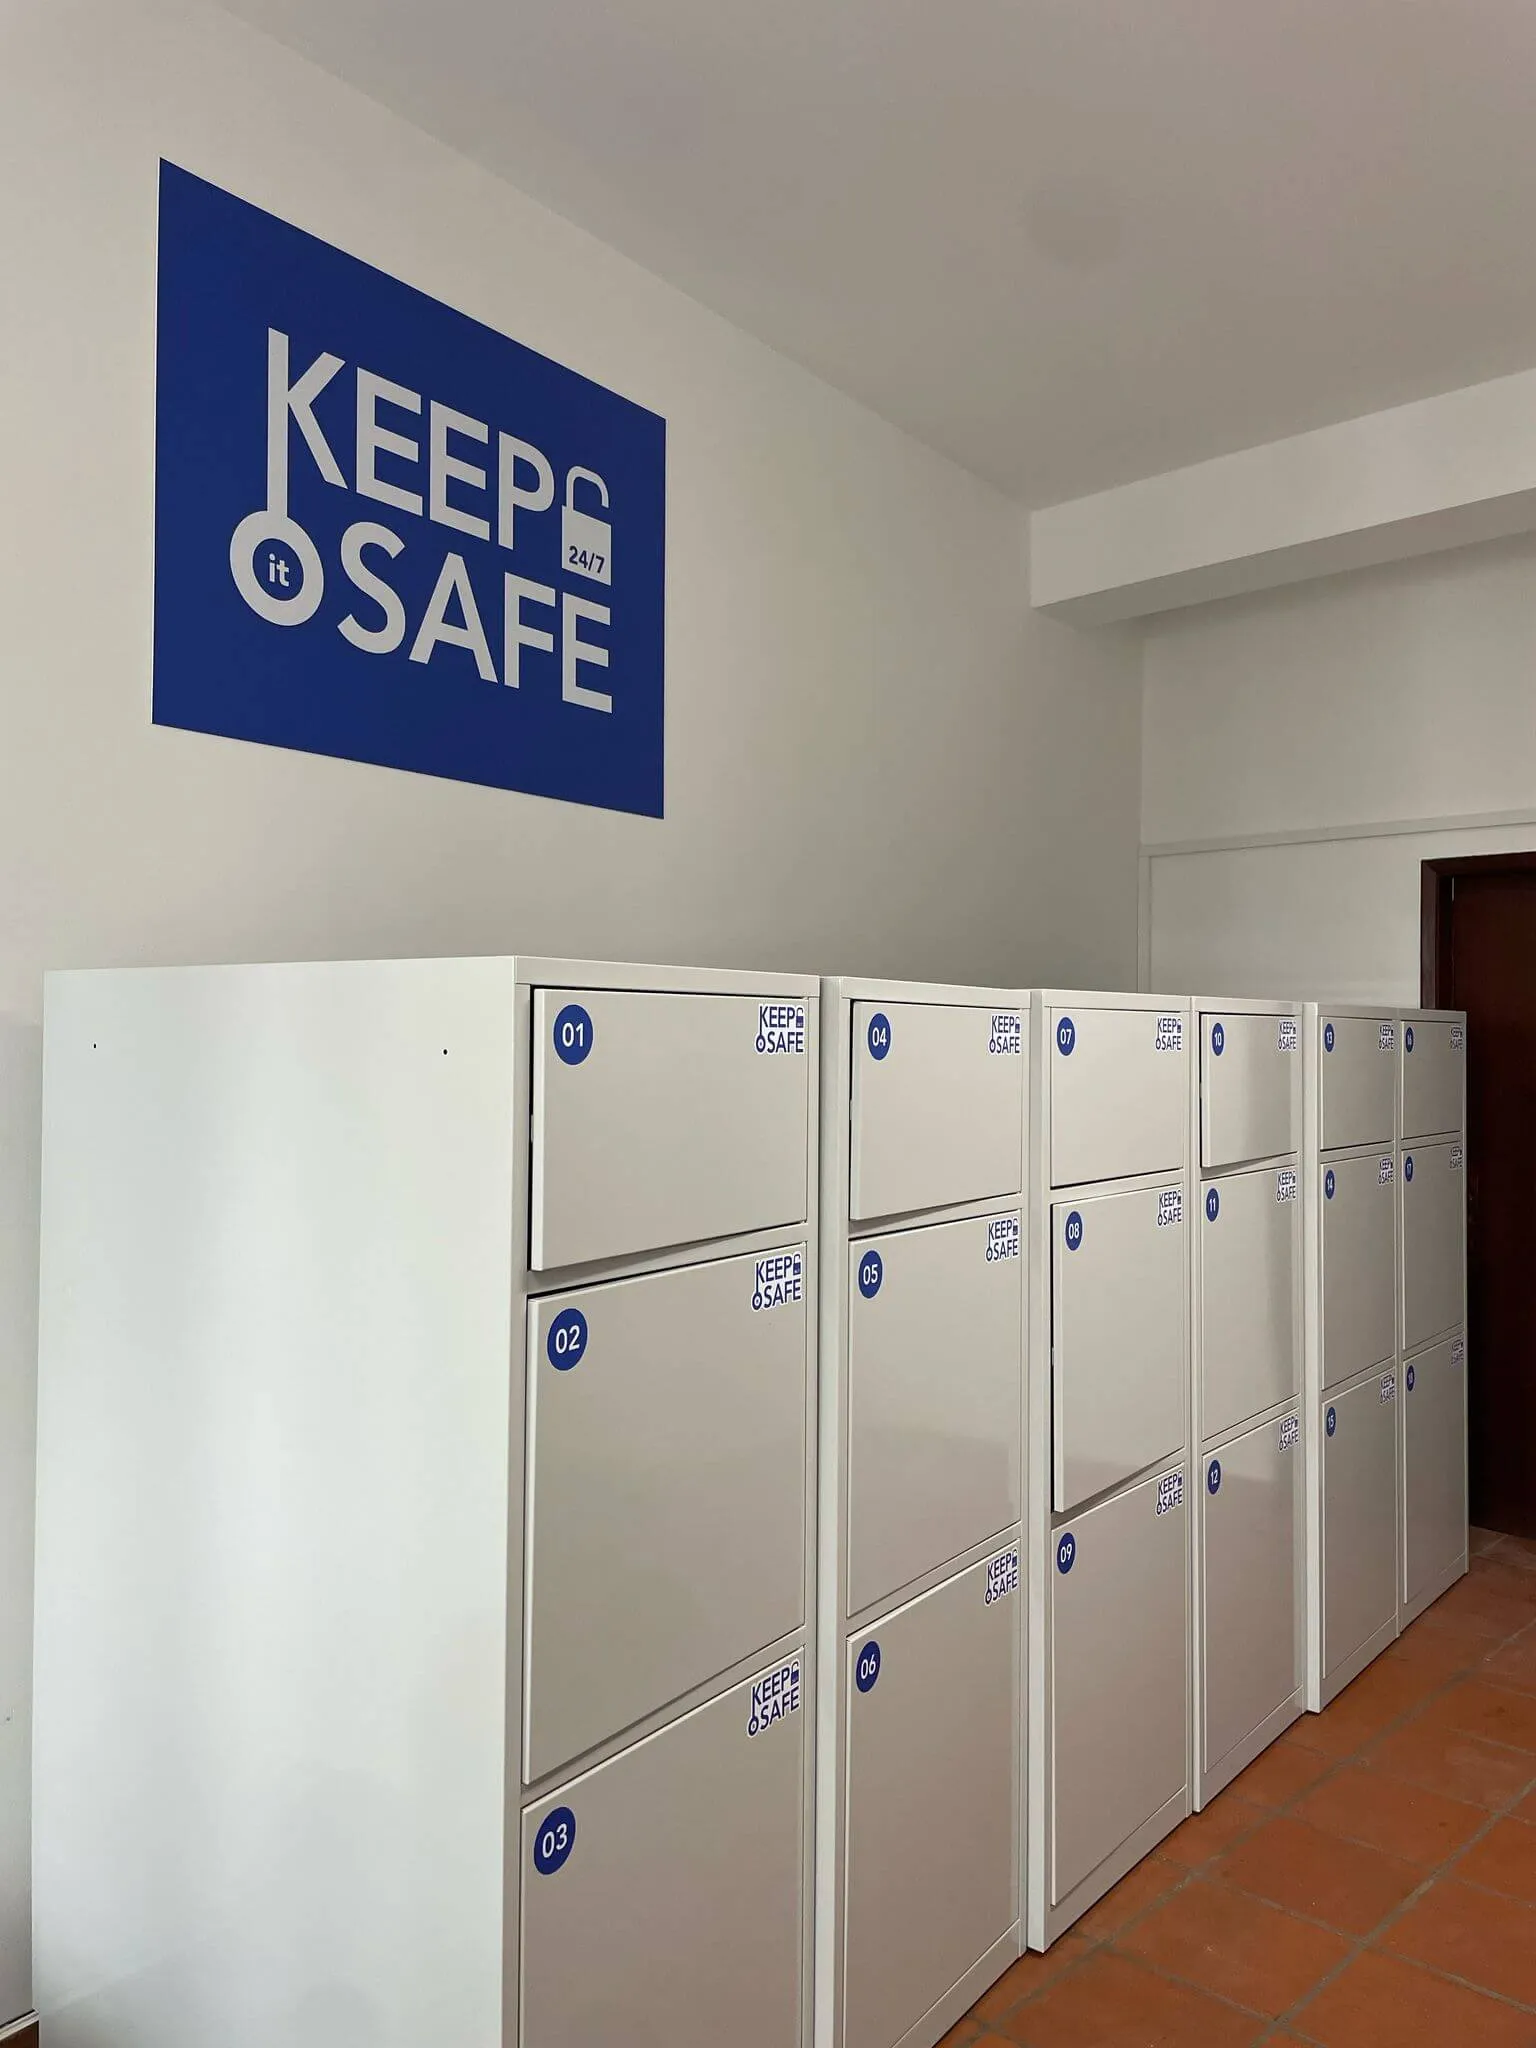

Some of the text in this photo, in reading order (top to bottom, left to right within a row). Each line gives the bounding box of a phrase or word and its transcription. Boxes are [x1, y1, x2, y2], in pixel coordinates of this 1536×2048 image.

[268, 327, 555, 550] KEEP
[568, 544, 605, 574] 24/7
[268, 553, 289, 587] it
[337, 521, 612, 714] SAFE
[760, 1006, 795, 1030] KEEP
[992, 1015, 1015, 1035] KEEP
[1157, 1018, 1177, 1035] KEEP
[1279, 1021, 1294, 1036] KEEP
[562, 1022, 585, 1048] 01
[767, 1031, 803, 1053] SAFE
[872, 1027, 887, 1047] 04
[996, 1036, 1020, 1054] SAFE
[1060, 1029, 1072, 1045] 07
[1162, 1035, 1182, 1050] SAFE
[1214, 1033, 1222, 1046] 10
[1282, 1036, 1297, 1050] SAFE
[1326, 1031, 1333, 1044] 13
[1277, 1171, 1293, 1188] KEEP
[1327, 1178, 1333, 1191] 14
[1159, 1191, 1178, 1210] KEEP
[1281, 1185, 1296, 1201] SAFE
[1209, 1198, 1216, 1212] 11
[1163, 1207, 1182, 1225] SAFE
[988, 1219, 1012, 1241] KEEP
[1068, 1222, 1080, 1239] 08
[994, 1239, 1018, 1261] SAFE
[756, 1255, 792, 1286] KEEP
[863, 1264, 878, 1285] 05
[763, 1278, 801, 1308] SAFE
[555, 1325, 580, 1354] 02
[1283, 1429, 1298, 1450] SAFE
[1158, 1473, 1178, 1497] KEEP
[1210, 1469, 1218, 1485] 12
[1162, 1489, 1182, 1513] SAFE
[1060, 1543, 1072, 1563] 09
[987, 1553, 1012, 1583] KEEP
[992, 1569, 1018, 1601] SAFE
[861, 1654, 876, 1680] 06
[752, 1667, 791, 1710] KEEP
[760, 1686, 800, 1730] SAFE
[542, 1823, 568, 1858] 03
